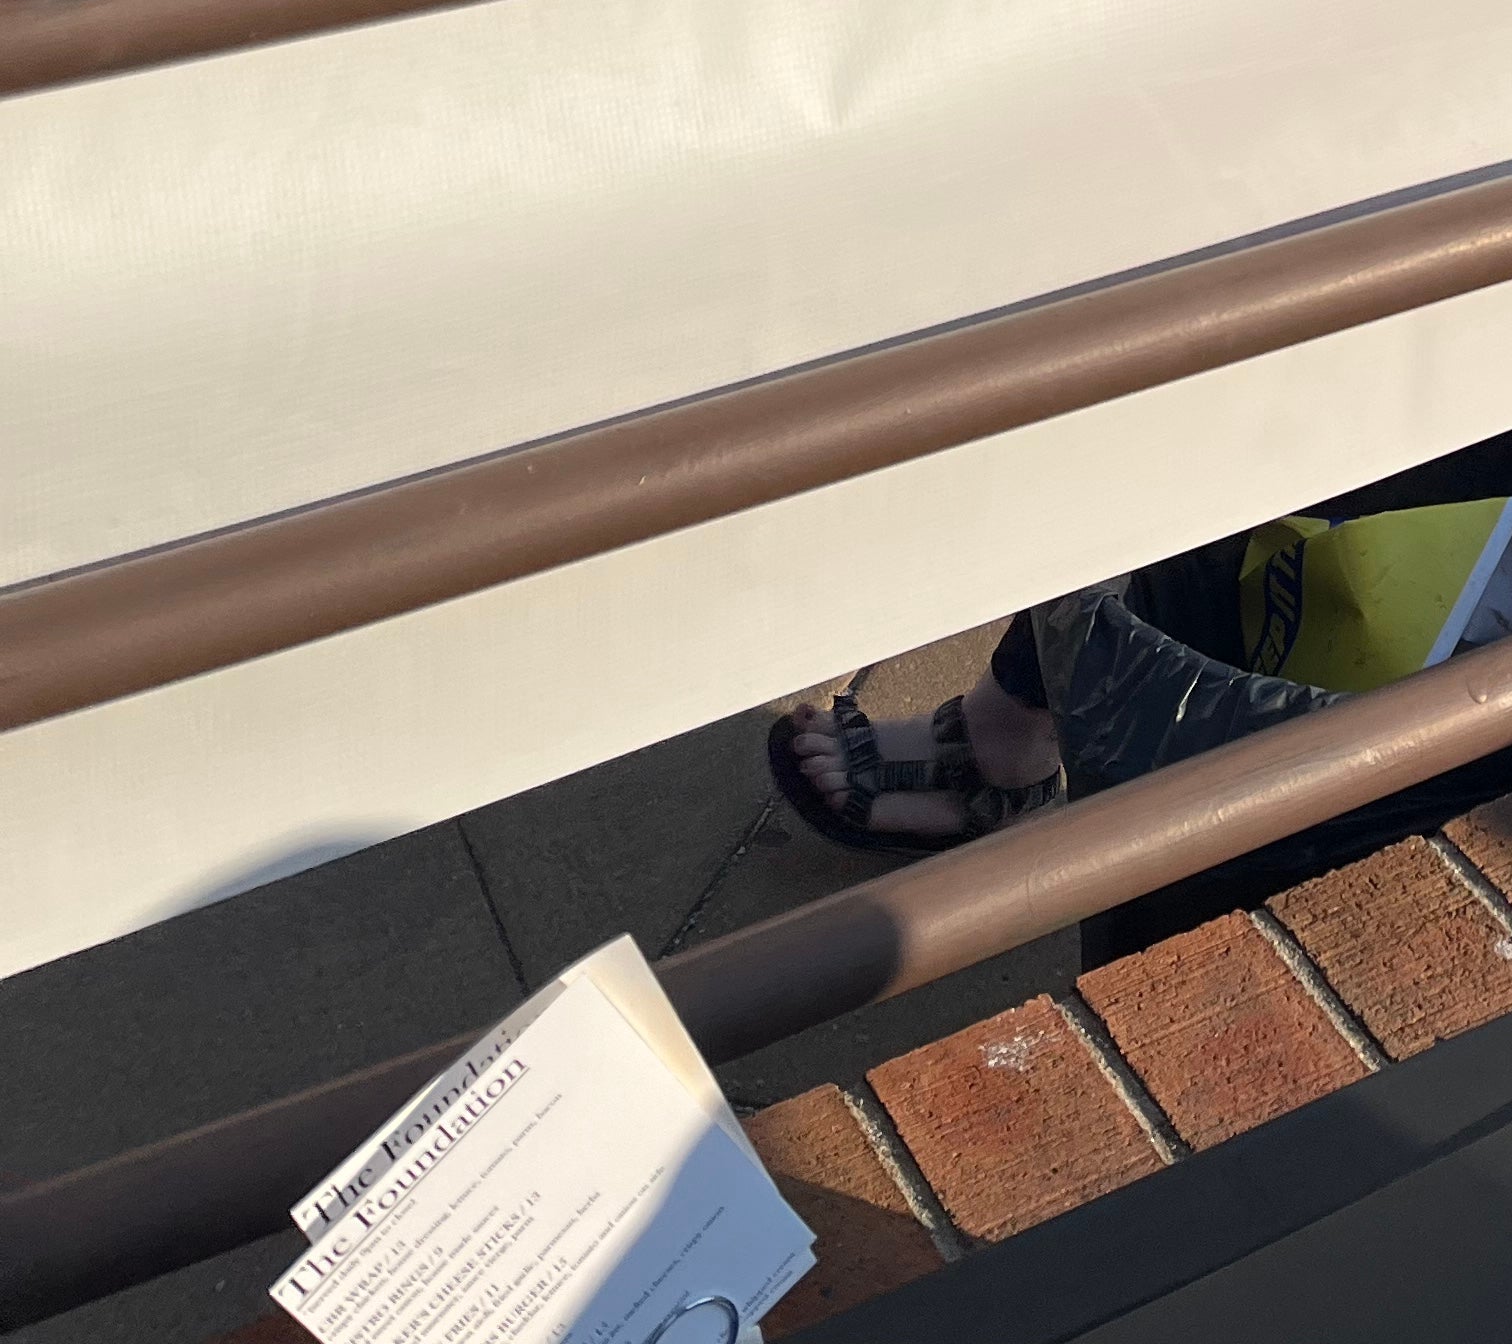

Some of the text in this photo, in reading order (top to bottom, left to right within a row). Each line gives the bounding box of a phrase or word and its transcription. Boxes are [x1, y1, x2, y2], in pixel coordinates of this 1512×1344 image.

[277, 1050, 528, 1302] The Foundation
[304, 1025, 533, 1228] The Foundati
